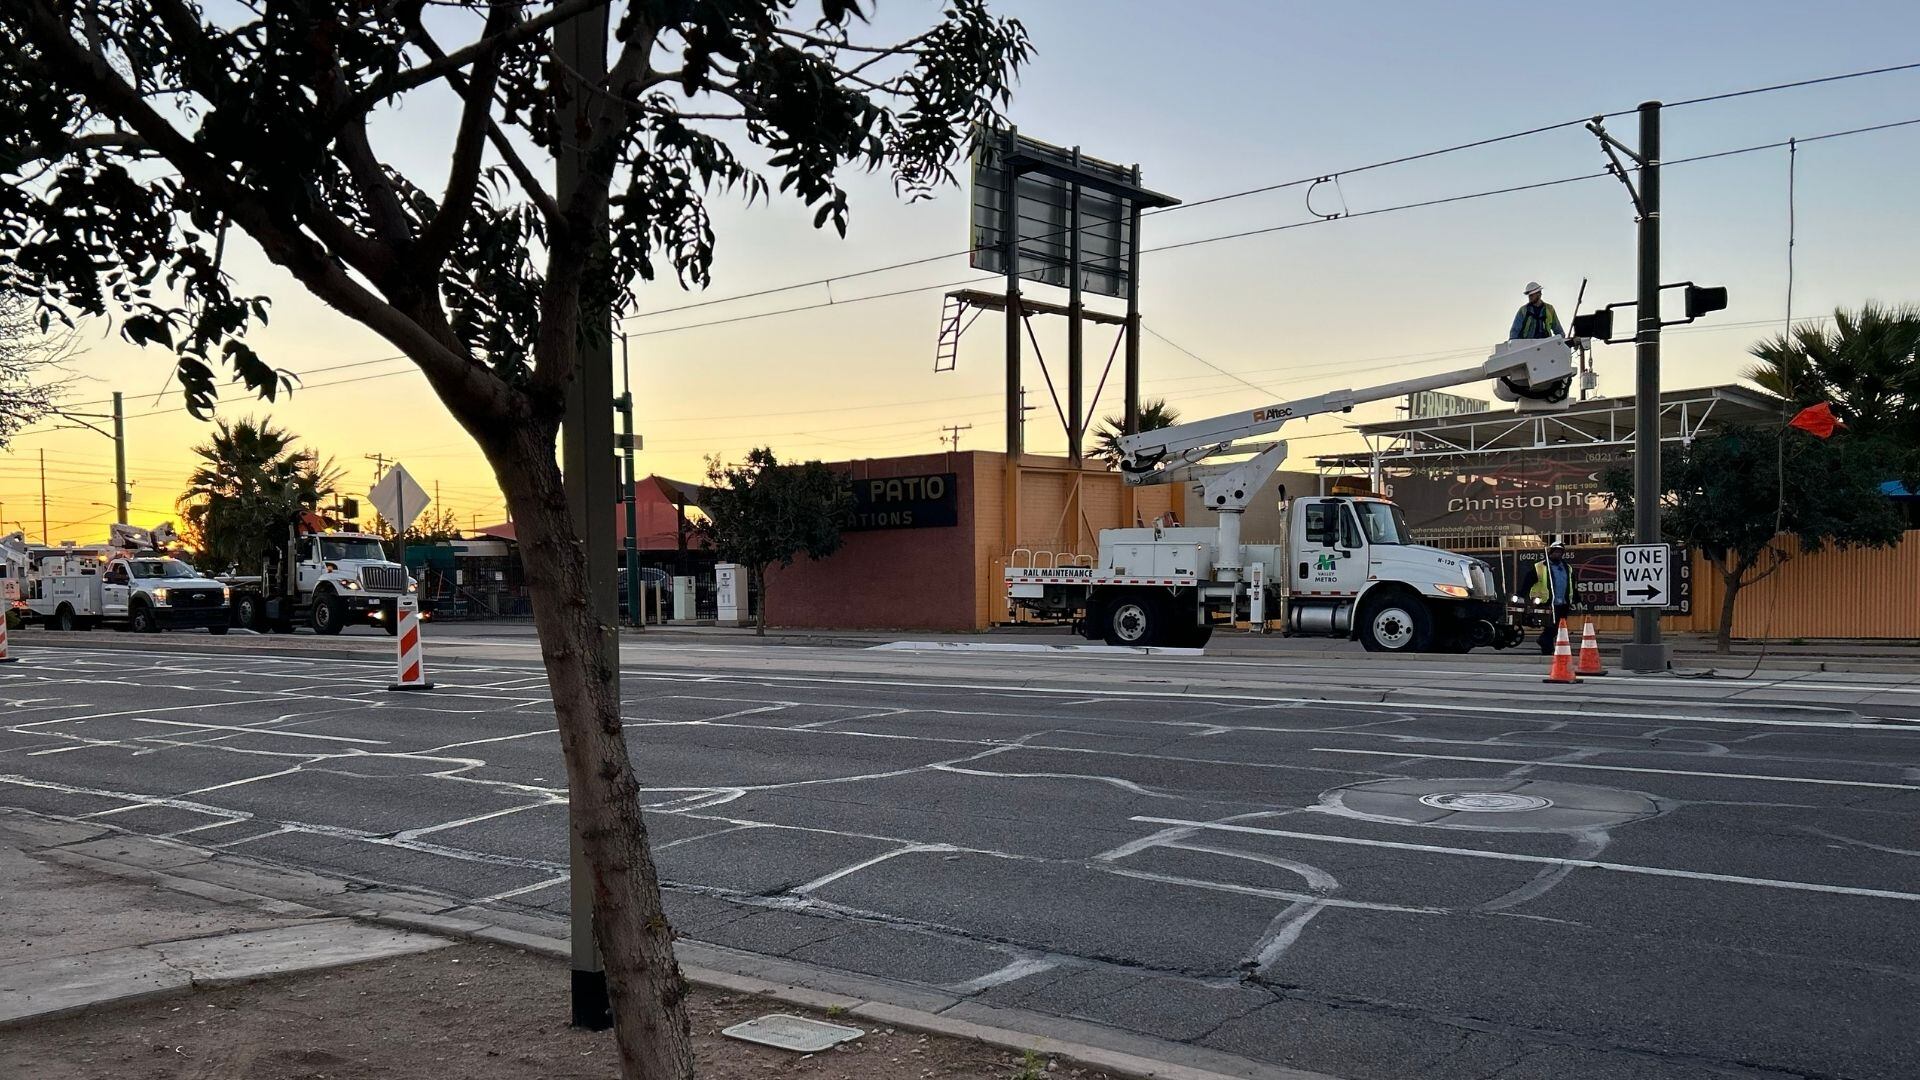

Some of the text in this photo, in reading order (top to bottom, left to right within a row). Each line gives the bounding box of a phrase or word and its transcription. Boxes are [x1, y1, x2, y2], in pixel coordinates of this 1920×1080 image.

[1411, 391, 1456, 419] LERNER
[1266, 408, 1292, 420] Altec
[870, 476, 944, 502] PATIO
[1555, 483, 1577, 491] SINCE
[1447, 490, 1602, 512] Christophe
[1463, 508, 1589, 523] AUTO BOD
[1519, 552, 1538, 562] (602)
[1624, 551, 1662, 564] ONE
[1023, 569, 1093, 577] RAIL MAINTENANCE
[1623, 568, 1663, 581] WAY
